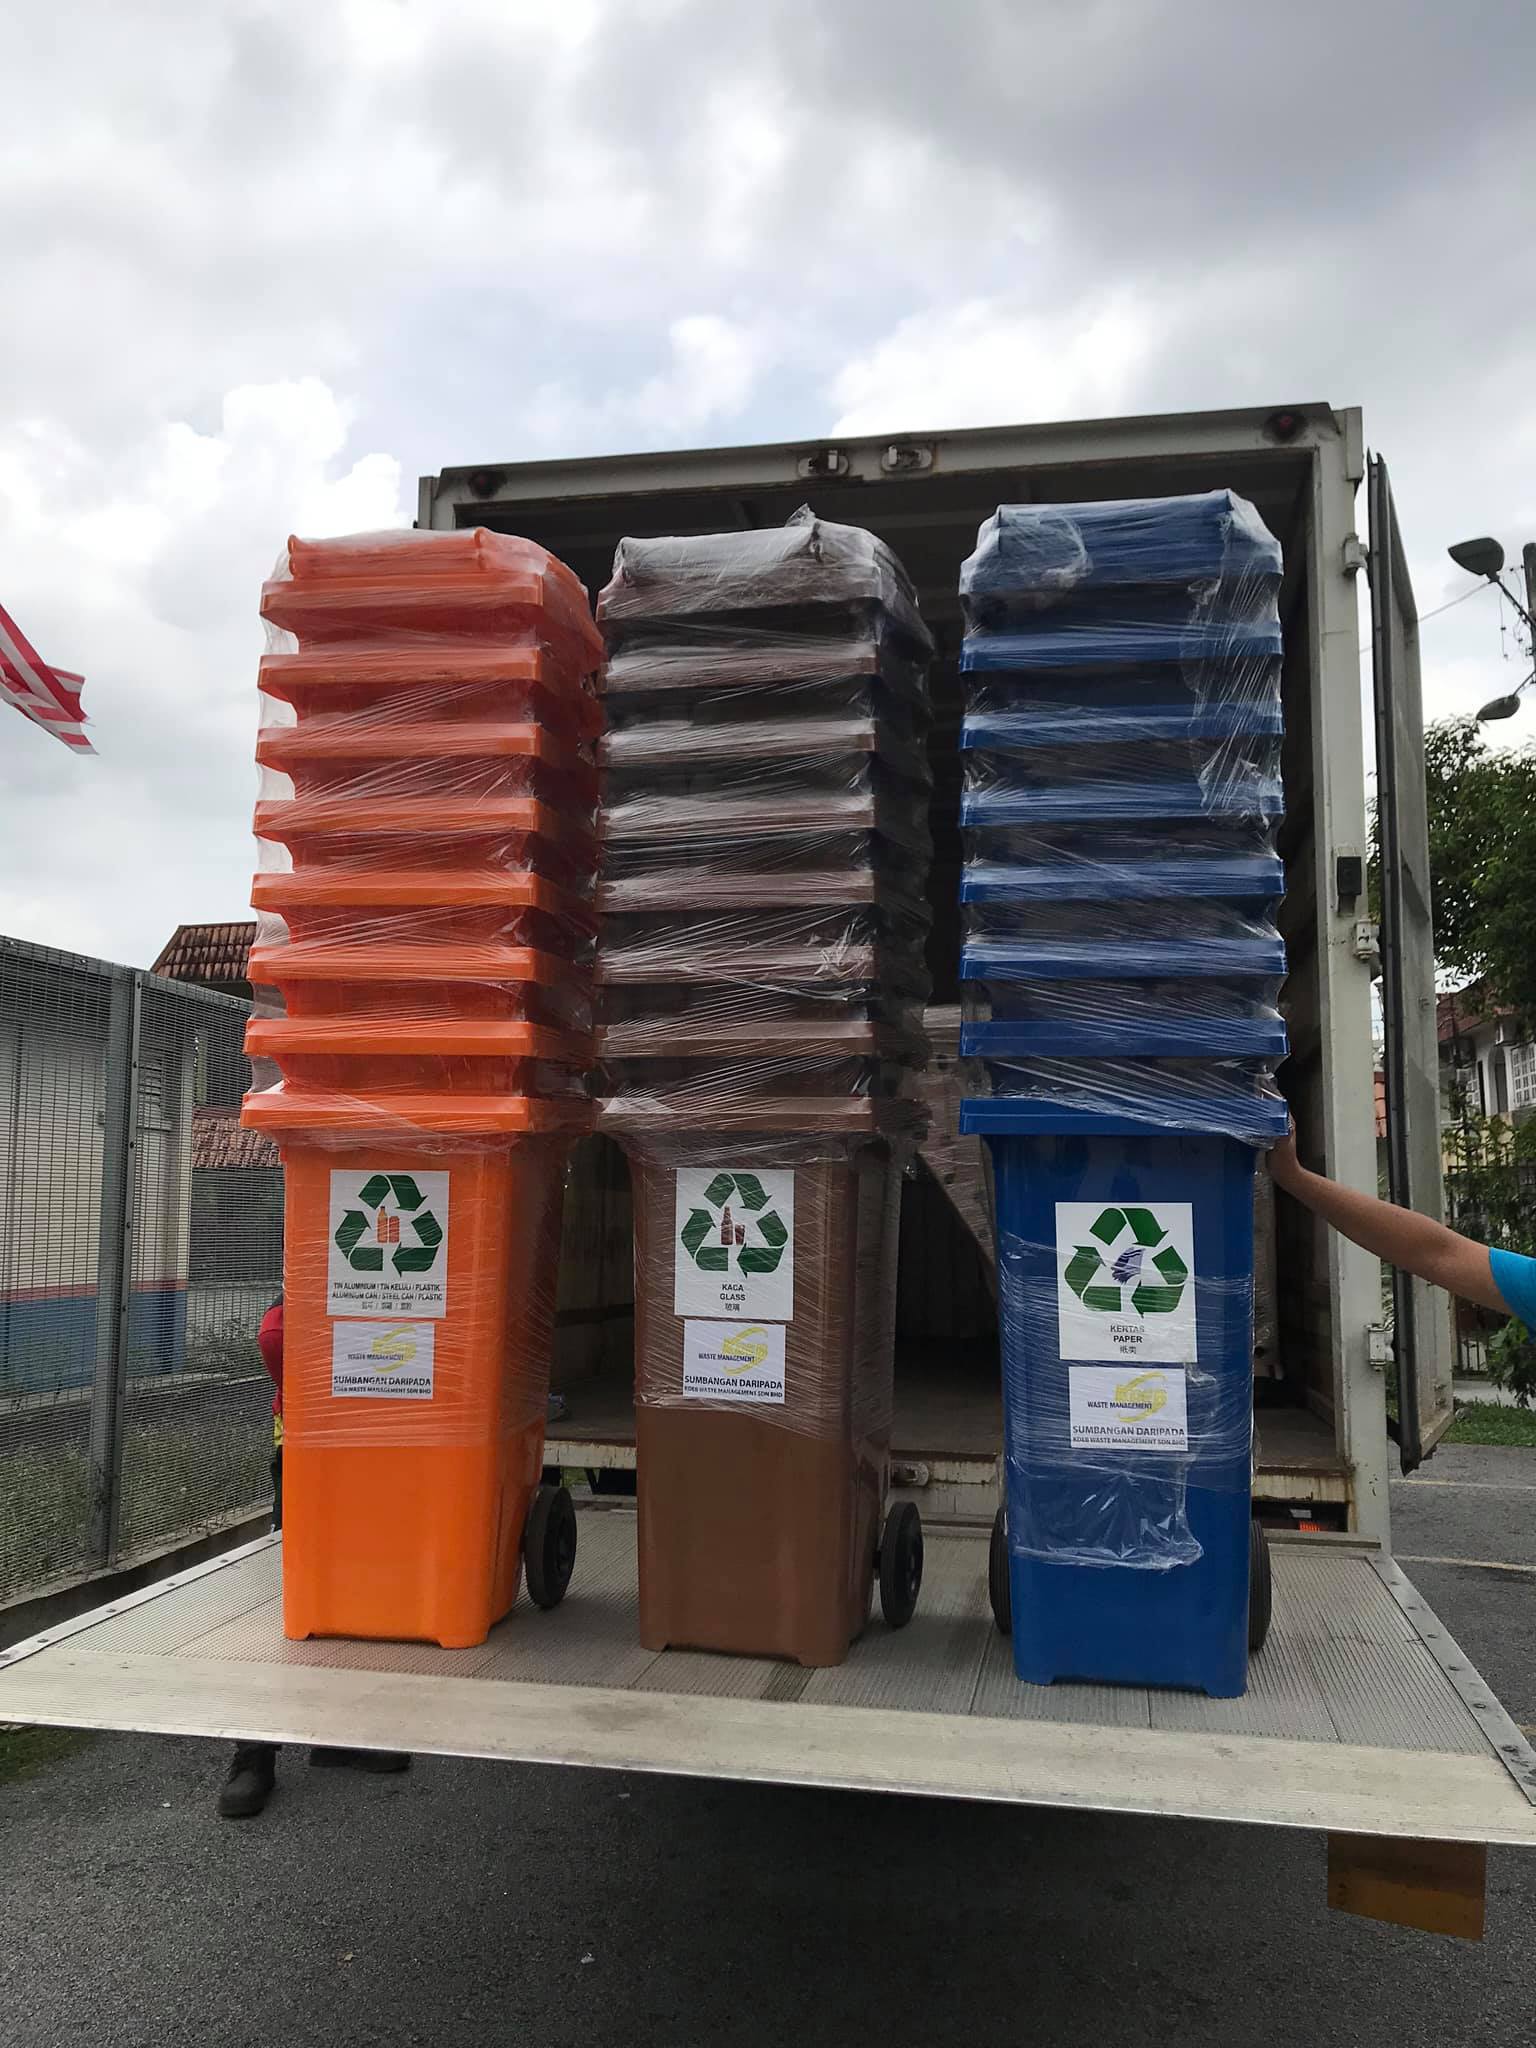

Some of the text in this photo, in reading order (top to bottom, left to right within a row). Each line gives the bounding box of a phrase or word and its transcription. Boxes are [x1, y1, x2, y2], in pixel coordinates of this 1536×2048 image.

[415, 1284, 441, 1292] PLASTIK
[721, 1283, 744, 1291] KACA
[382, 1292, 400, 1300] STEEL
[418, 1293, 443, 1301] PLASTIC
[719, 1292, 746, 1301] GLASS
[1110, 1324, 1145, 1333] KERTAS
[1113, 1335, 1143, 1343] PAPER
[698, 1352, 755, 1362] WASTE MANAGEMENT
[333, 1375, 431, 1386] SUMBANGAN DARIPADA
[684, 1375, 783, 1390] SUMBANGAN DARIPADA
[1087, 1401, 1153, 1410] WASTE MANAGEMENT
[1072, 1425, 1185, 1437] SUMBANGAN DARIPADA
[1090, 1436, 1111, 1444] WASTE
